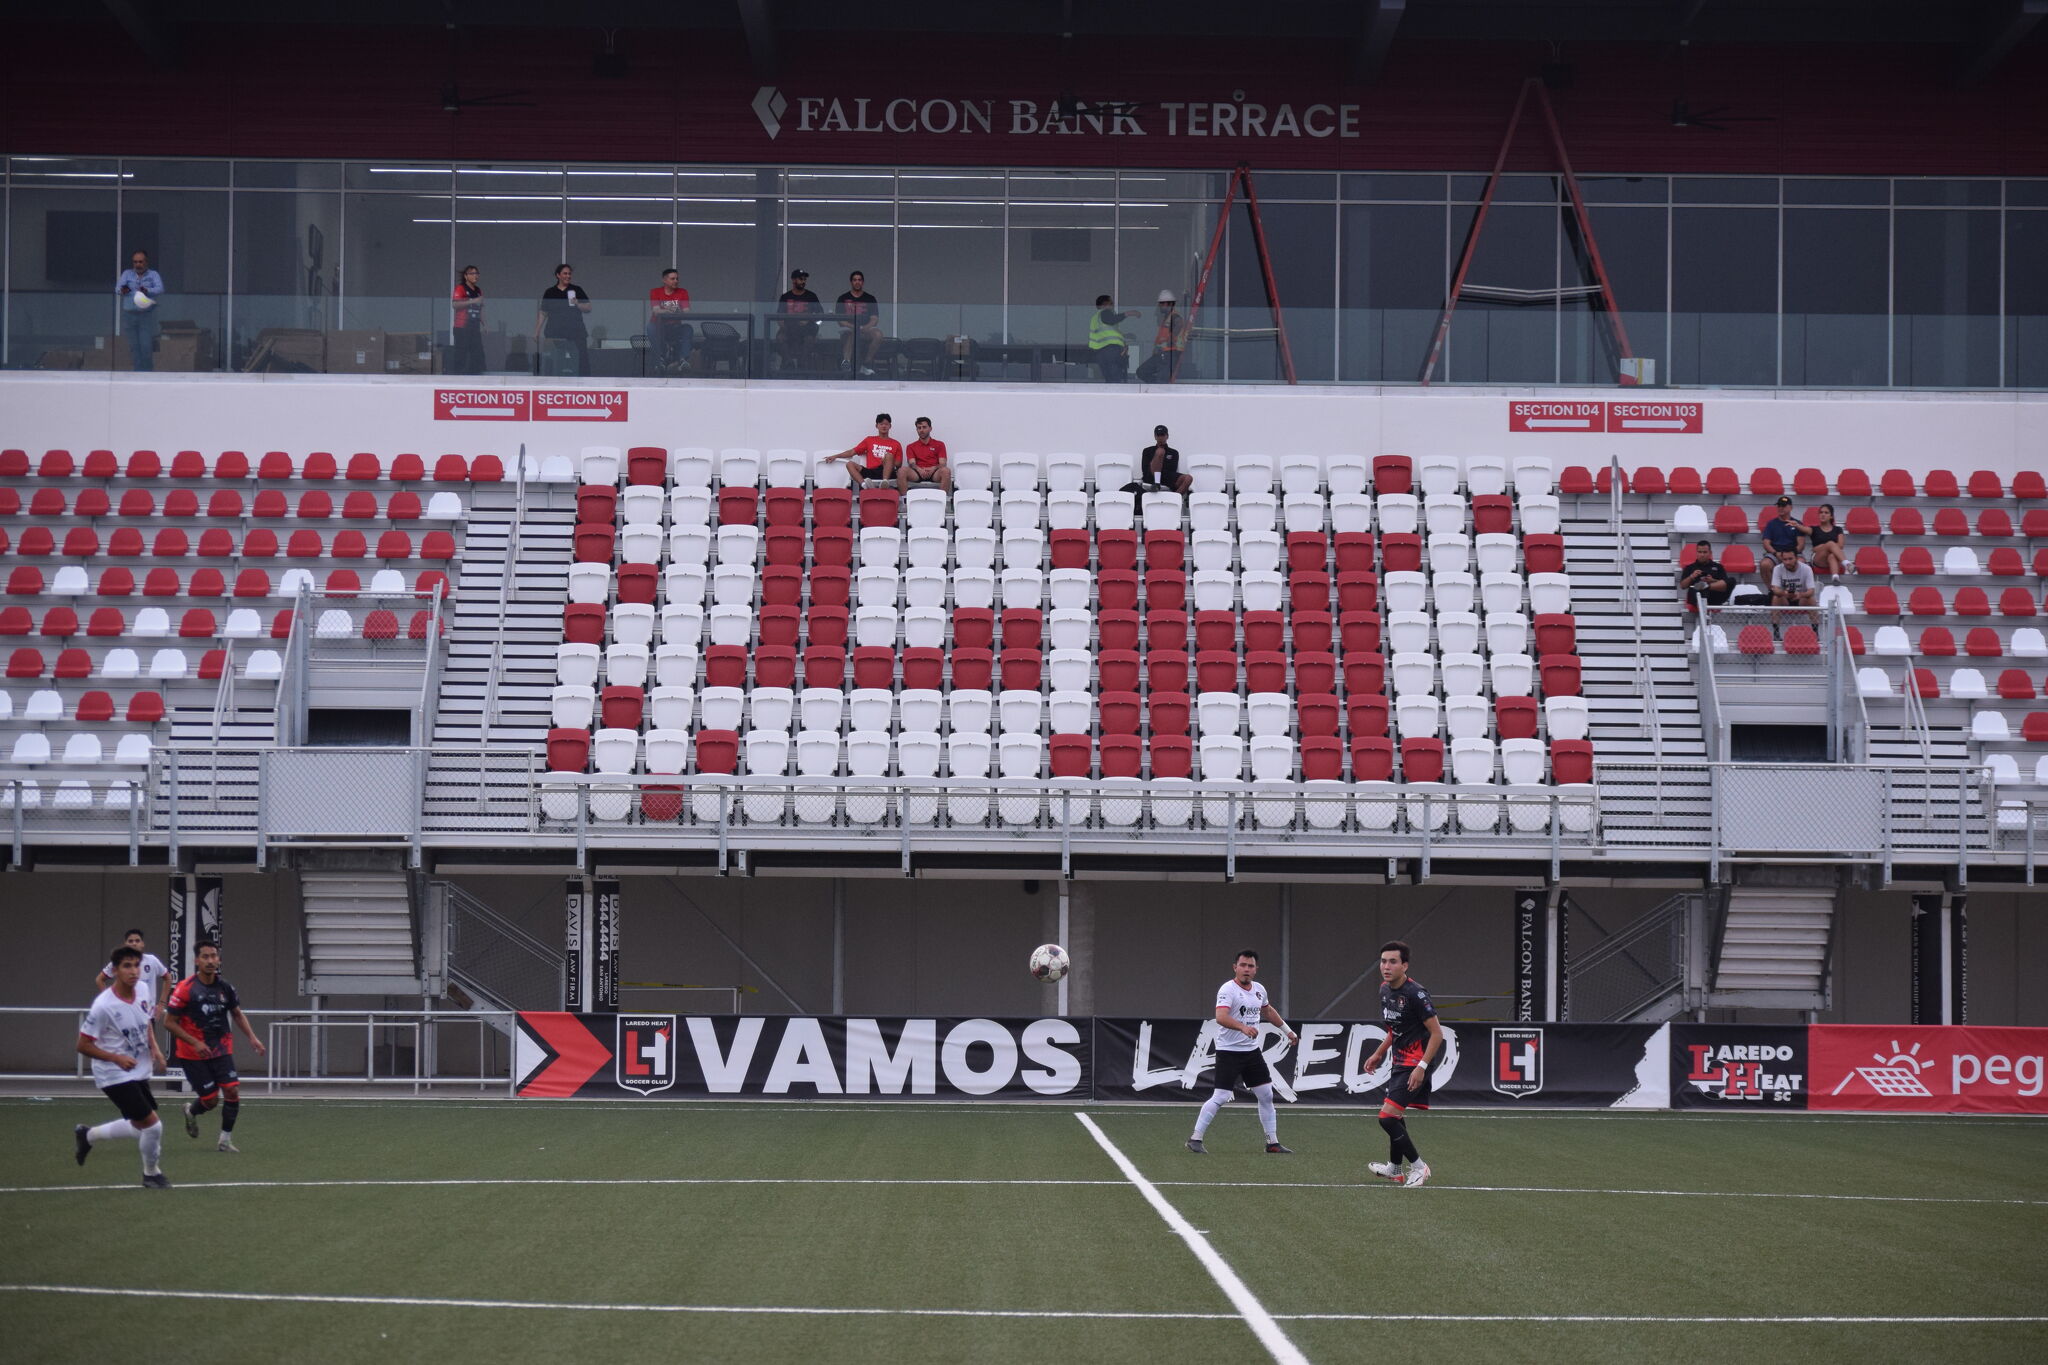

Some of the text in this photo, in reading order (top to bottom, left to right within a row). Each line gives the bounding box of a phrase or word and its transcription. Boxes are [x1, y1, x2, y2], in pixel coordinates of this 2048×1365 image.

[796, 97, 1361, 138] FALCON BANK TERRACE
[440, 393, 524, 405] SECTION 105
[538, 393, 622, 405] SECTION 104
[1515, 404, 1600, 416] SECTION 104
[1613, 405, 1697, 417] SECTION 103
[569, 898, 578, 947] DAVIS
[599, 894, 609, 961] 444.4444
[170, 921, 181, 989] stewar
[569, 953, 577, 974] LAW
[1521, 913, 1532, 1022] FALCON BANK
[686, 1017, 1082, 1095] VAMOS
[1688, 1044, 1794, 1084] LAREDO
[1774, 1090, 1792, 1102] SC
